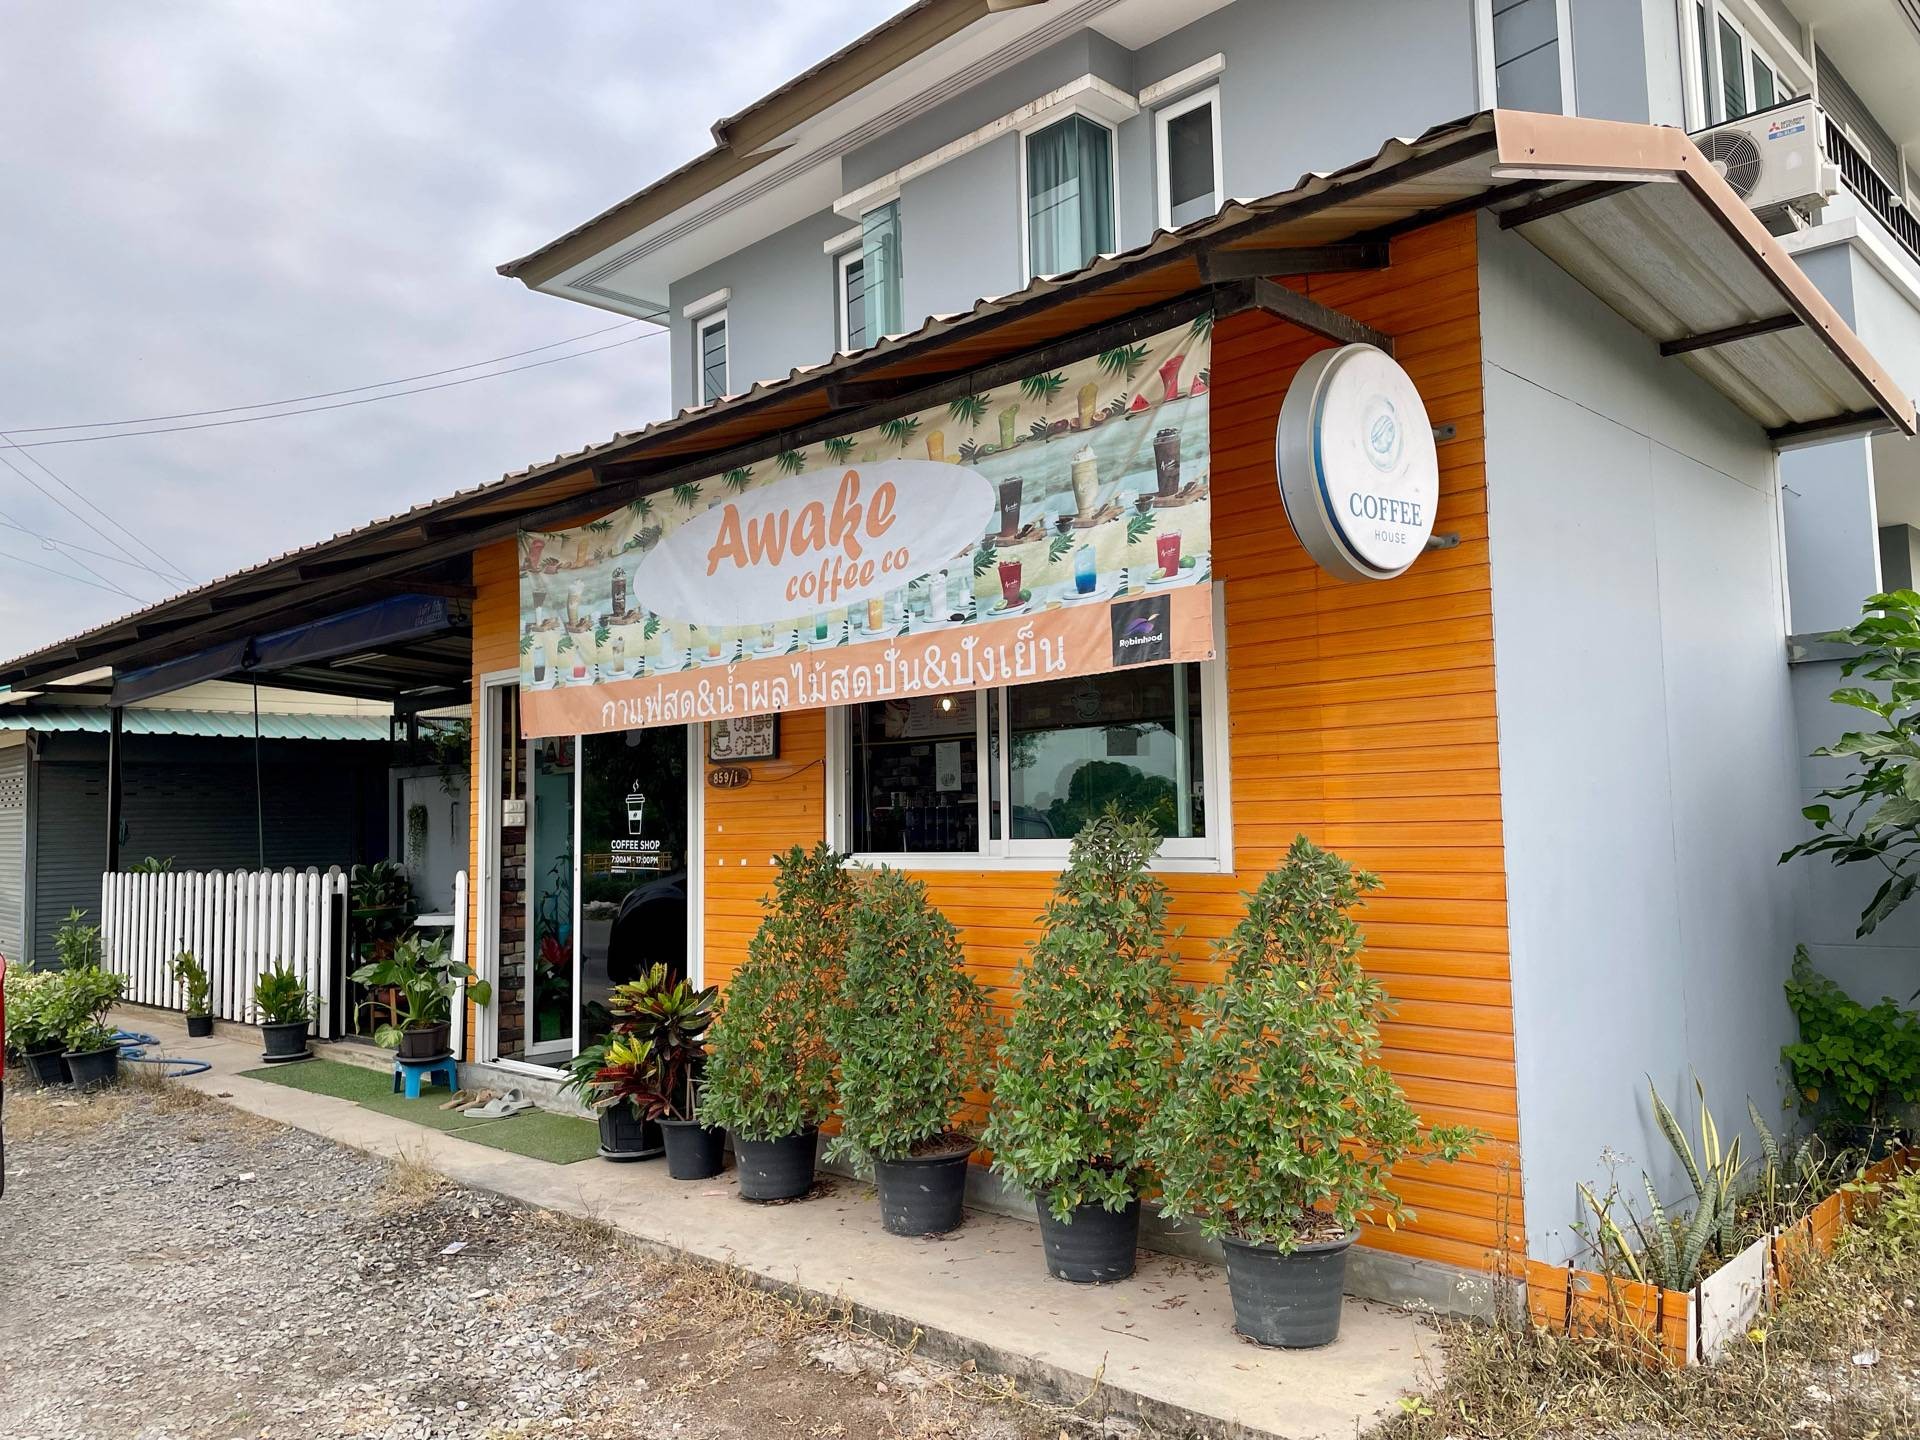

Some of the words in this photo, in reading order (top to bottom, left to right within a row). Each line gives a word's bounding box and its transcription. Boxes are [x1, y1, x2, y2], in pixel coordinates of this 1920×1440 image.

[1350, 492, 1422, 527] COFFEE
[707, 469, 897, 576] Awake
[1375, 529, 1406, 544] HOUSE
[785, 555, 875, 605] coffee
[881, 546, 909, 573] co
[1119, 632, 1163, 648] Robinhood
[735, 734, 771, 755] OPEN
[611, 840, 639, 850] COFFEE
[640, 840, 660, 850] SHOP
[611, 855, 631, 864] 7:00AM
[636, 856, 659, 864] 17:00PM
